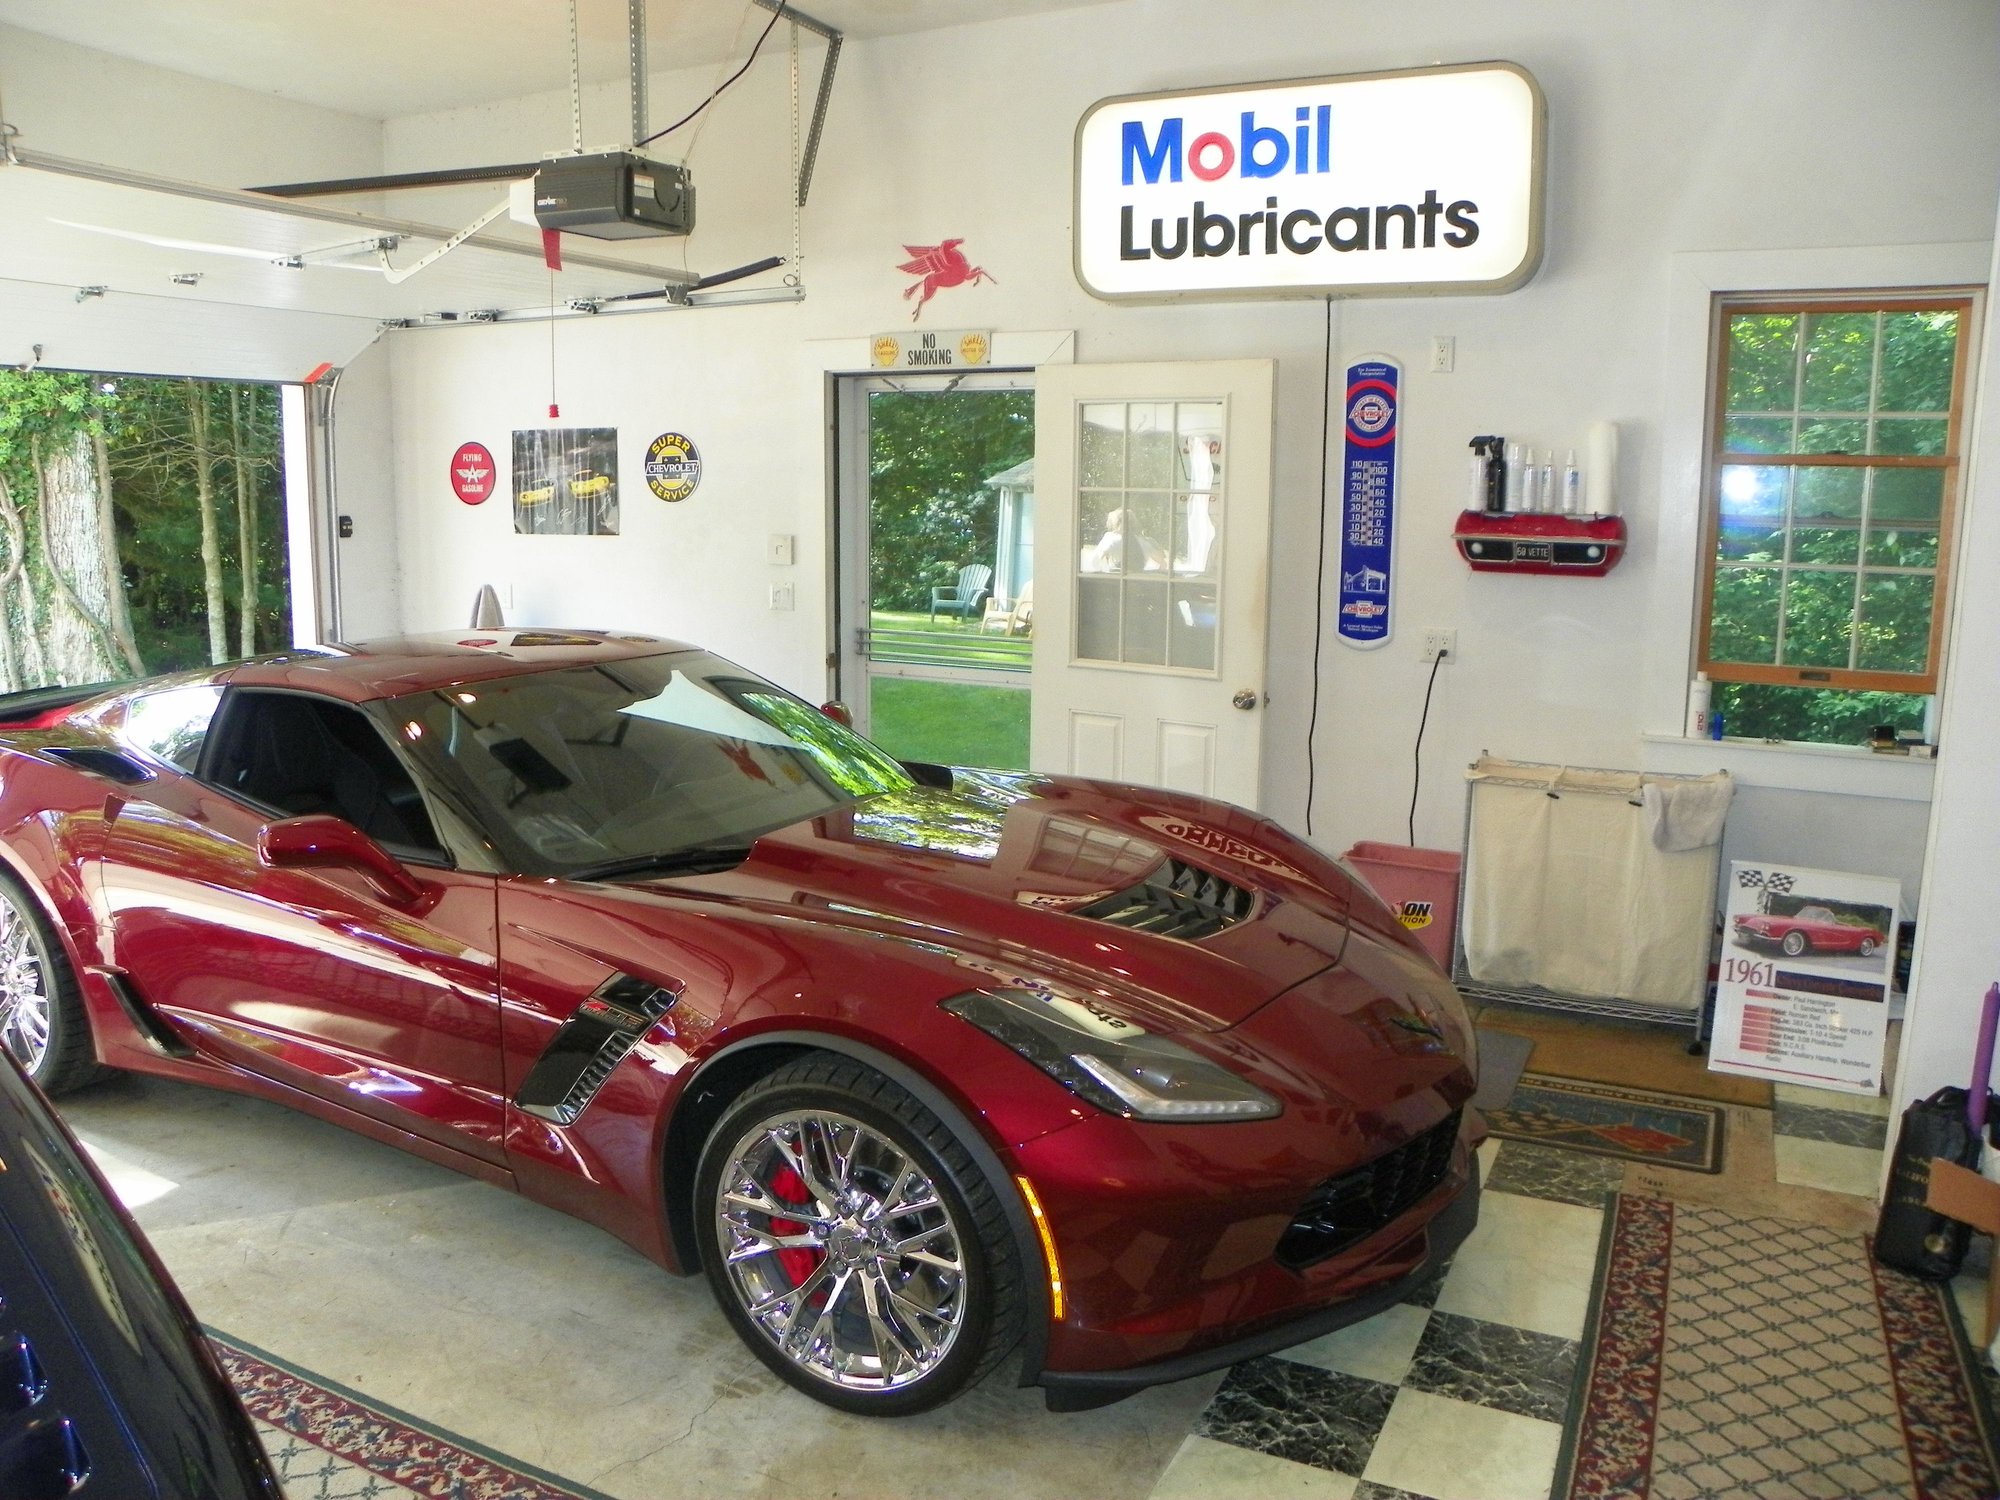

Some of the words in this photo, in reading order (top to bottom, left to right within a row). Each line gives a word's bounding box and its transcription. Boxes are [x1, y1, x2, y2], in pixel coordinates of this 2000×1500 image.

[1120, 104, 1332, 186] Mobil
[1120, 189, 1480, 261] Lubricants
[878, 339, 896, 350] SHELL
[923, 333, 936, 349] NO
[964, 336, 984, 347] SHELL
[908, 349, 952, 365] SMOKING
[1353, 410, 1388, 419] CHEVROLET
[651, 434, 691, 454] SUPER
[462, 453, 482, 462] FLYING
[648, 463, 697, 473] CHEVROLET
[461, 484, 484, 493] GASOLINE
[650, 479, 695, 500] SERVICE
[1529, 547, 1549, 557] VETTE
[1347, 606, 1382, 614] CHEVROLET
[1400, 916, 1426, 924] TION
[1725, 957, 1774, 988] 1961
[1810, 1013, 1820, 1021] Red
